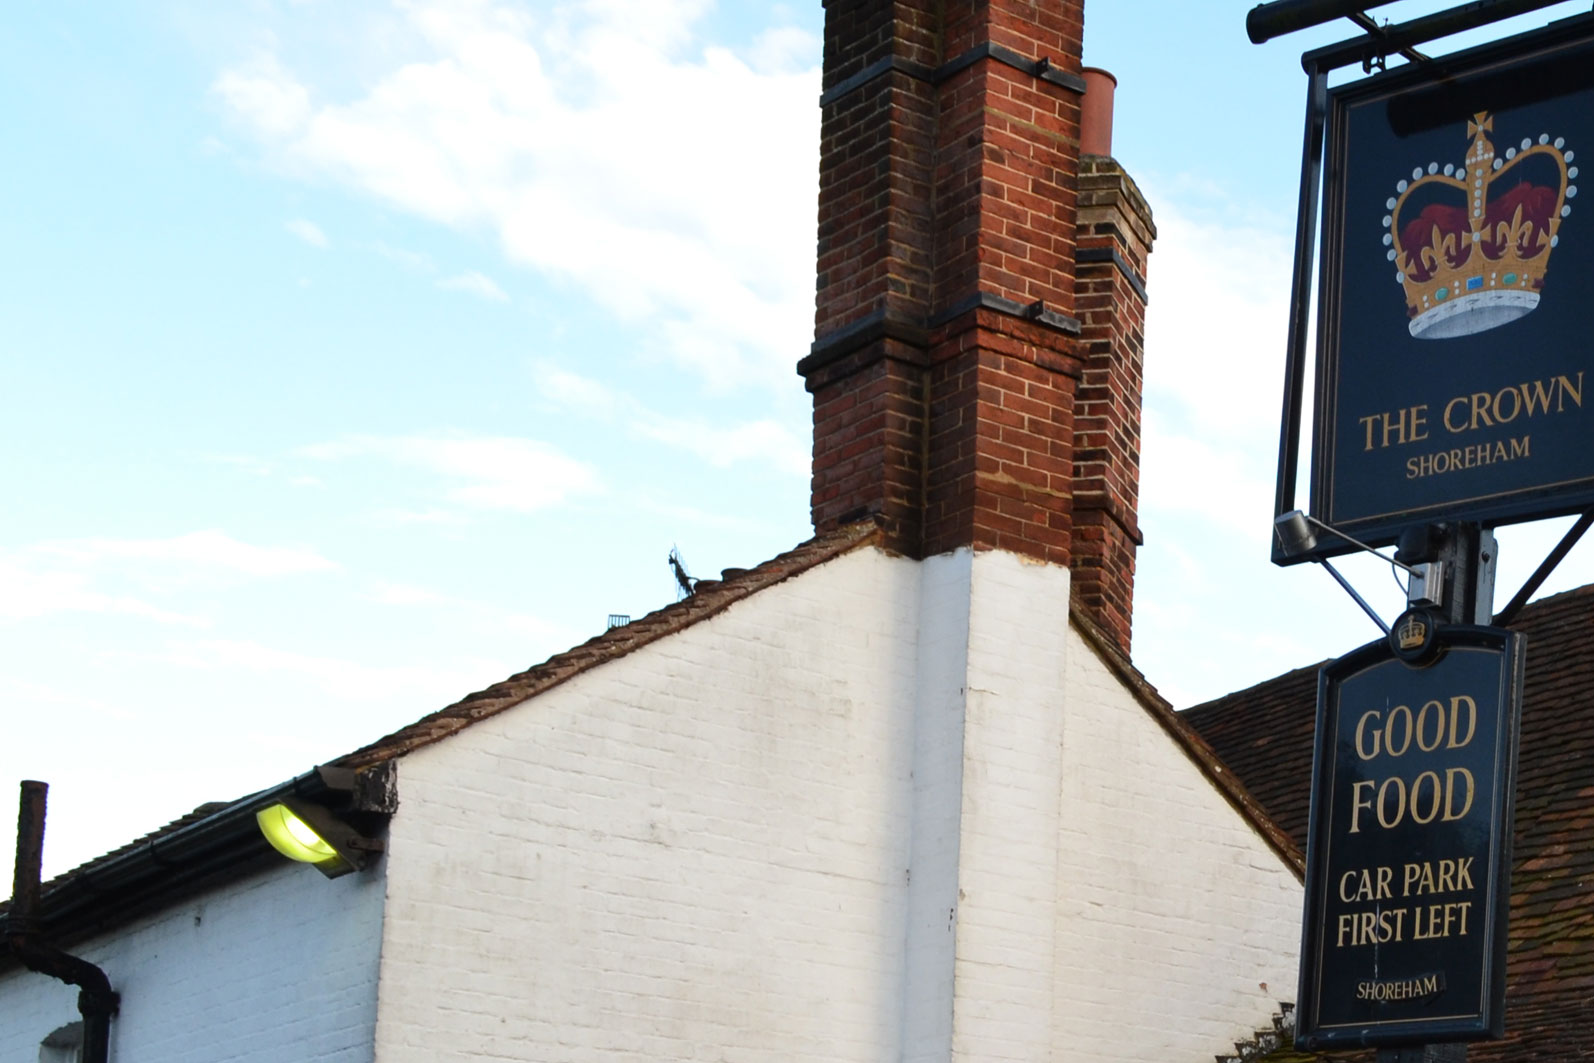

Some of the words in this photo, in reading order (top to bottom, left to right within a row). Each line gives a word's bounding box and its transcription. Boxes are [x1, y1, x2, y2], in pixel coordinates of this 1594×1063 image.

[1359, 405, 1429, 451] THE
[1443, 371, 1585, 434] CROWN
[1406, 435, 1531, 479] SHOREHAM
[1354, 695, 1478, 761] GOOD
[1349, 767, 1475, 834] FOOD
[1339, 866, 1393, 903] CAR
[1403, 856, 1475, 897] PARK
[1336, 908, 1407, 948] FIRST
[1413, 902, 1472, 941] LEFT
[1356, 974, 1438, 1000] SHOREHAM
